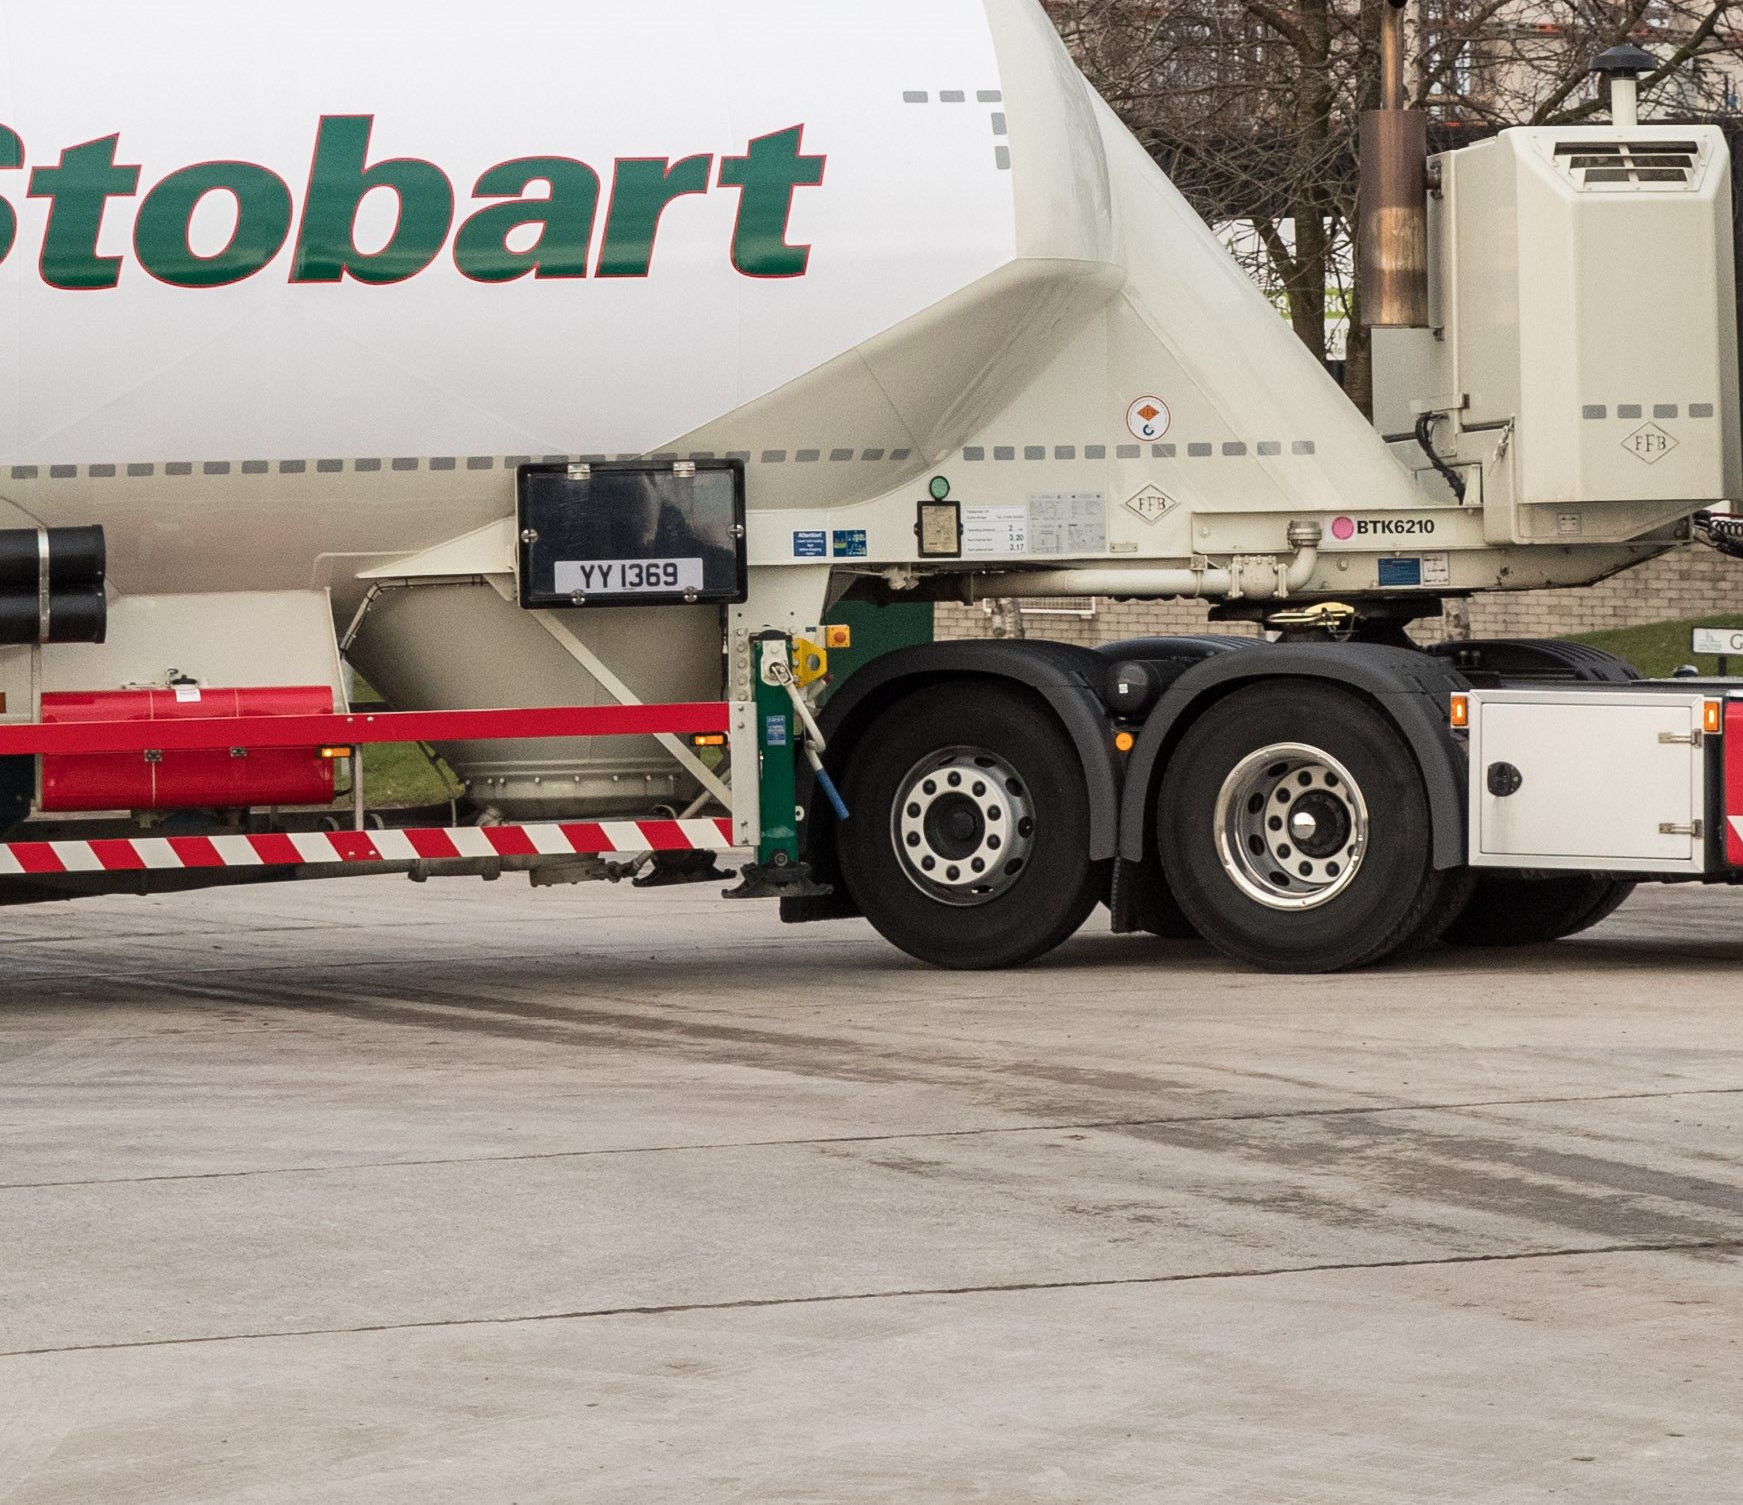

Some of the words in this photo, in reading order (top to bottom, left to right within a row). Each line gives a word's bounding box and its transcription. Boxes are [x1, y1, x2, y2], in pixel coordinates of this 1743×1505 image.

[1635, 433, 1666, 452] FFB
[1138, 496, 1166, 511] FFB
[1357, 519, 1435, 535] BTK6210
[580, 564, 613, 589] YY
[621, 562, 678, 588] 1369
